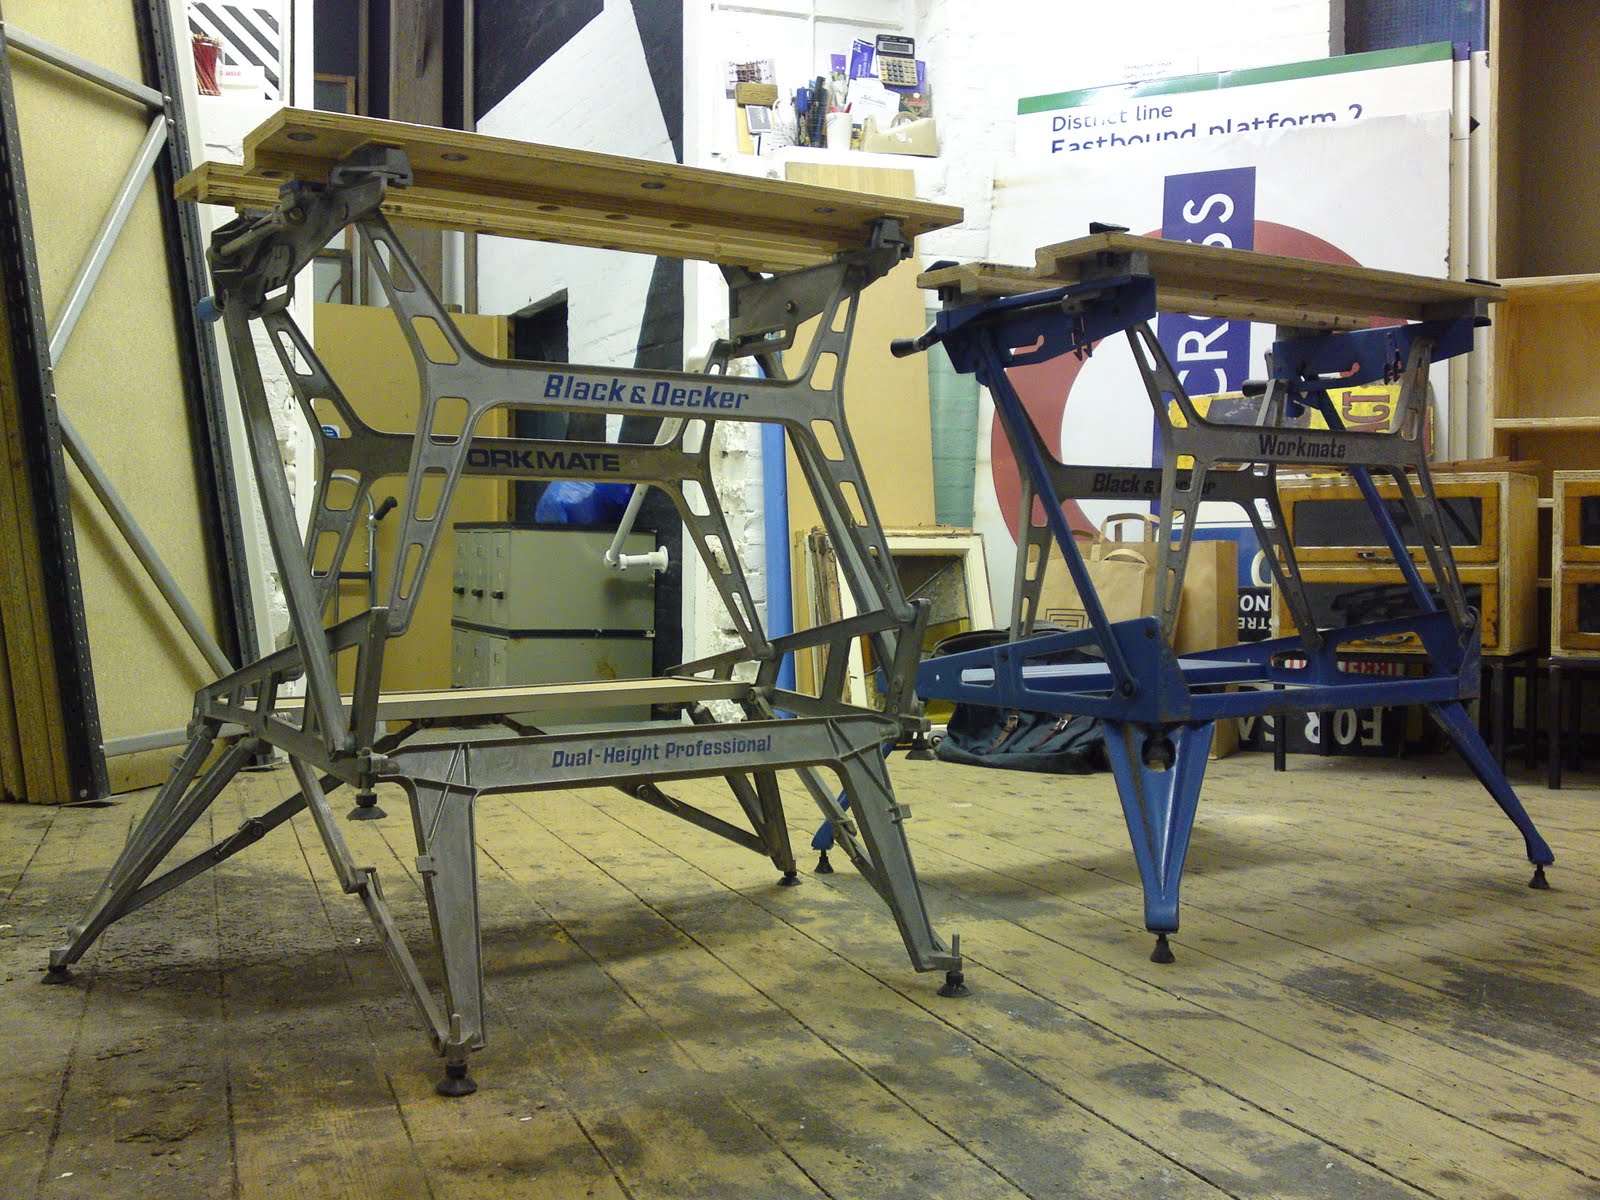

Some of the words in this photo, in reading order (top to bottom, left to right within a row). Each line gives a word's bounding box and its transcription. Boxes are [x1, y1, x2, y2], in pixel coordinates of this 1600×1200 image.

[1052, 110, 1128, 132] Distrct
[1136, 104, 1173, 121] line
[1176, 193, 1235, 394] CRS
[543, 374, 627, 403] Black
[629, 385, 646, 405] &
[650, 381, 749, 409] Decker
[1258, 434, 1346, 459] Workmate
[466, 448, 621, 472] ORKMATE
[1091, 472, 1140, 494] Black
[665, 735, 772, 759] Professional
